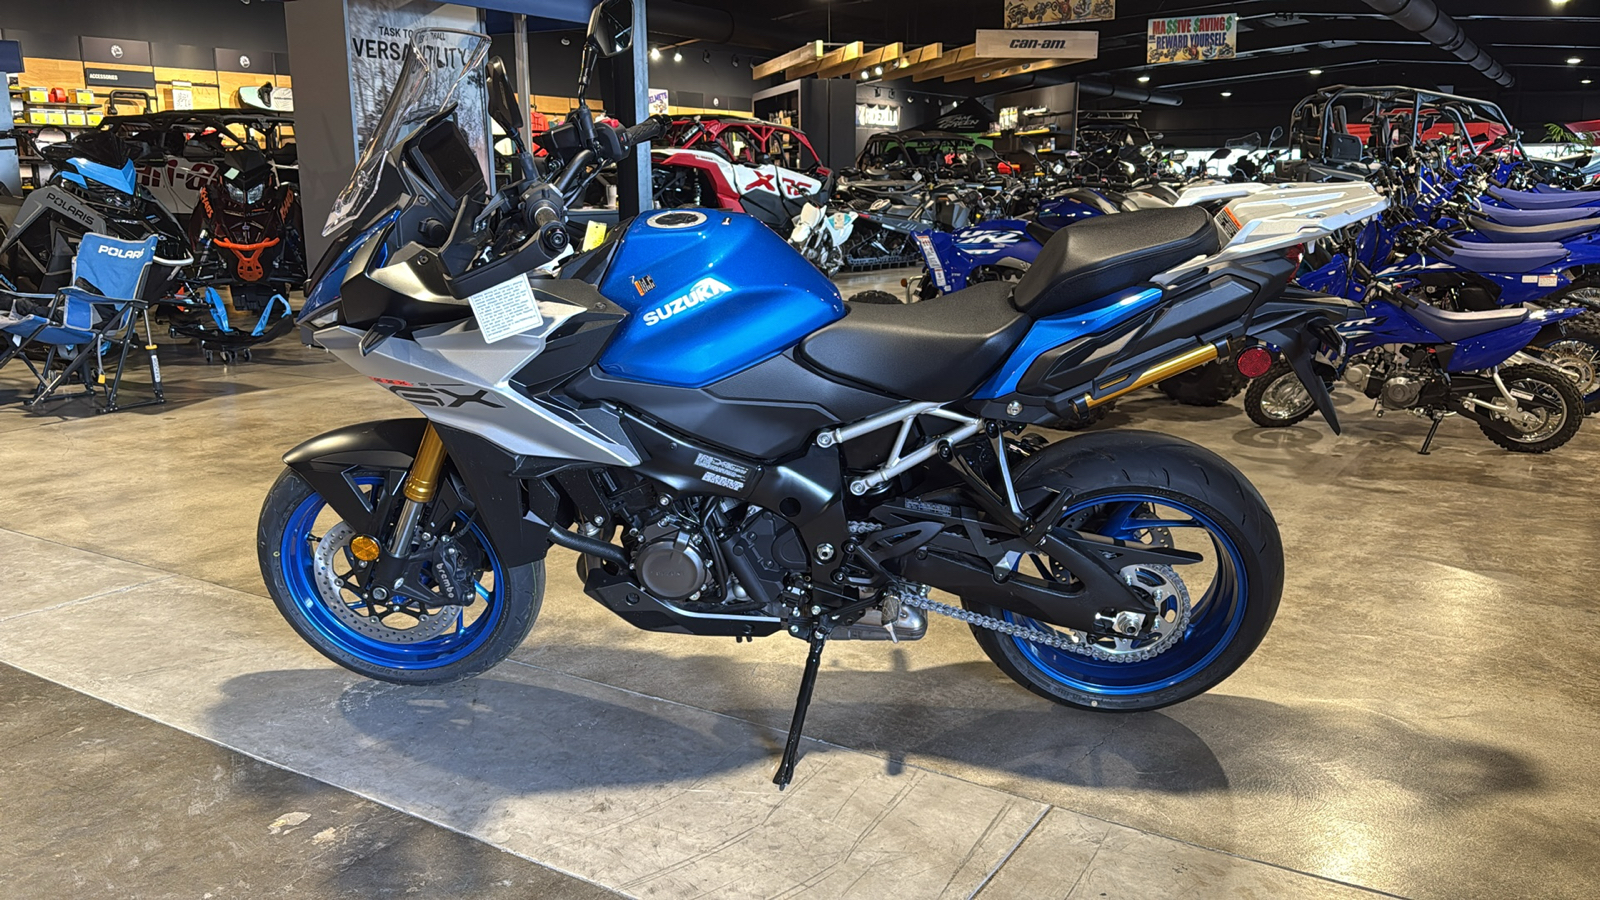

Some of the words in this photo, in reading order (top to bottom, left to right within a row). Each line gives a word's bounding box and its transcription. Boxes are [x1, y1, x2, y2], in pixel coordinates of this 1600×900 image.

[378, 26, 401, 38] TASK
[1009, 39, 1066, 49] can-am
[1156, 34, 1188, 50] REWARD
[1189, 32, 1227, 48] YOURSELF
[89, 72, 119, 81] ACCESSORIES
[648, 91, 667, 104] ELMETS
[46, 192, 95, 225] POLARIS
[200, 186, 214, 219] KHAOS
[436, 562, 455, 599] brembo
